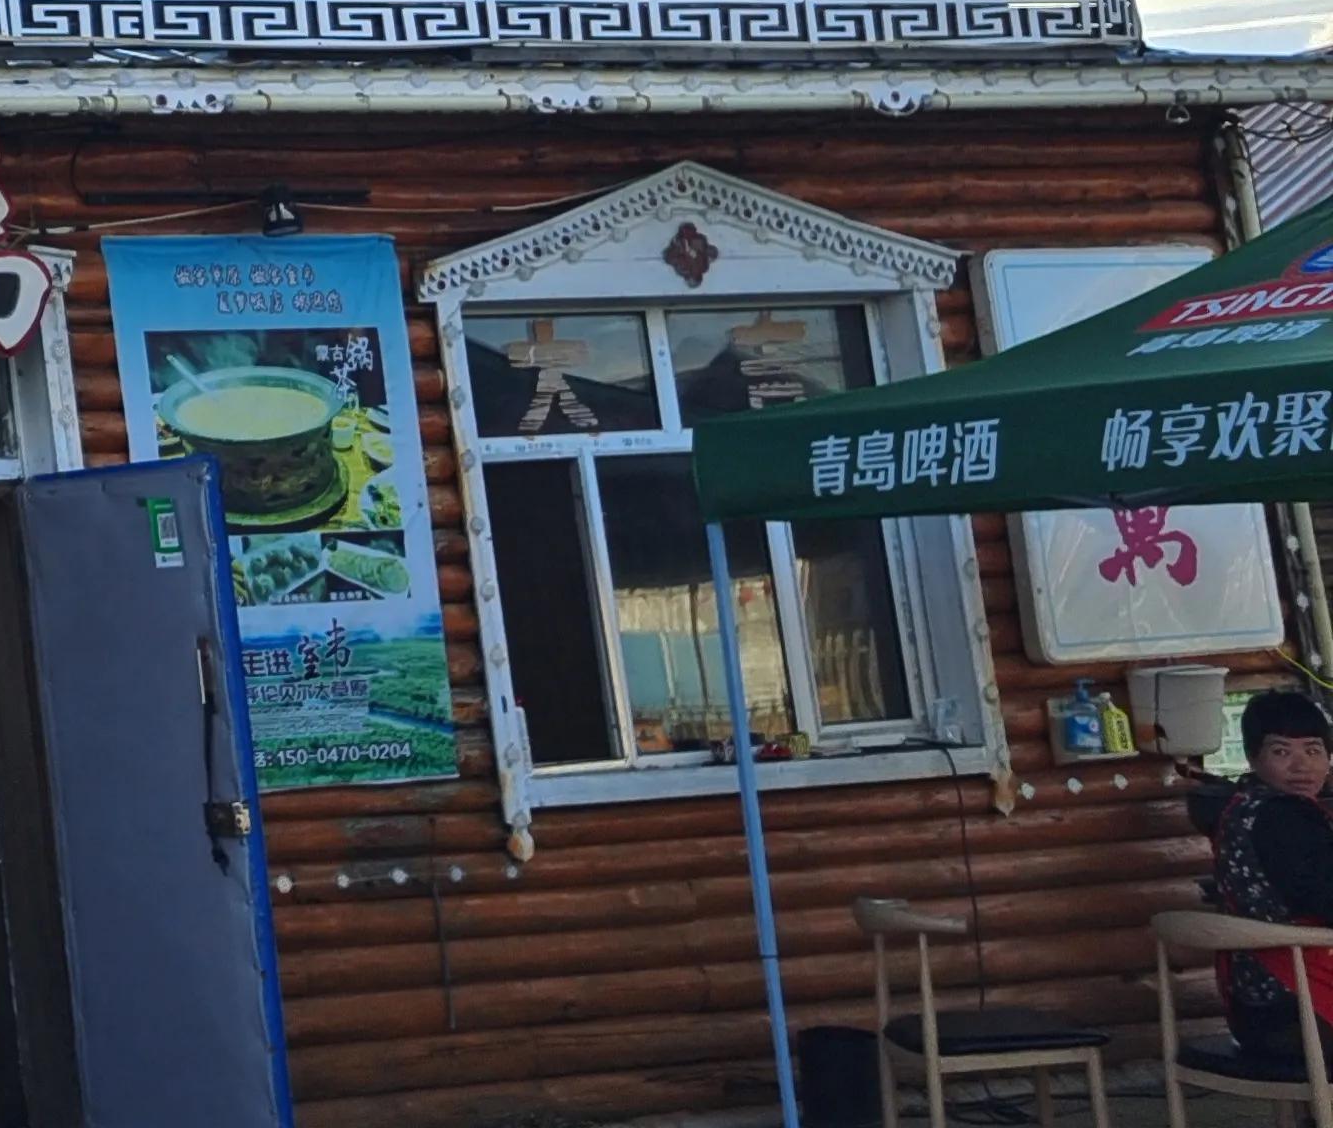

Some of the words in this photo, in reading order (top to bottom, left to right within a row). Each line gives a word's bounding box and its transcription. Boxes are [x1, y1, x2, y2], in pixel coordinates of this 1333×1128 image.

[1169, 282, 1333, 324] TSINGT
[807, 416, 1000, 497] 青岛啤酒
[1099, 390, 1333, 472] 畅享欢聚
